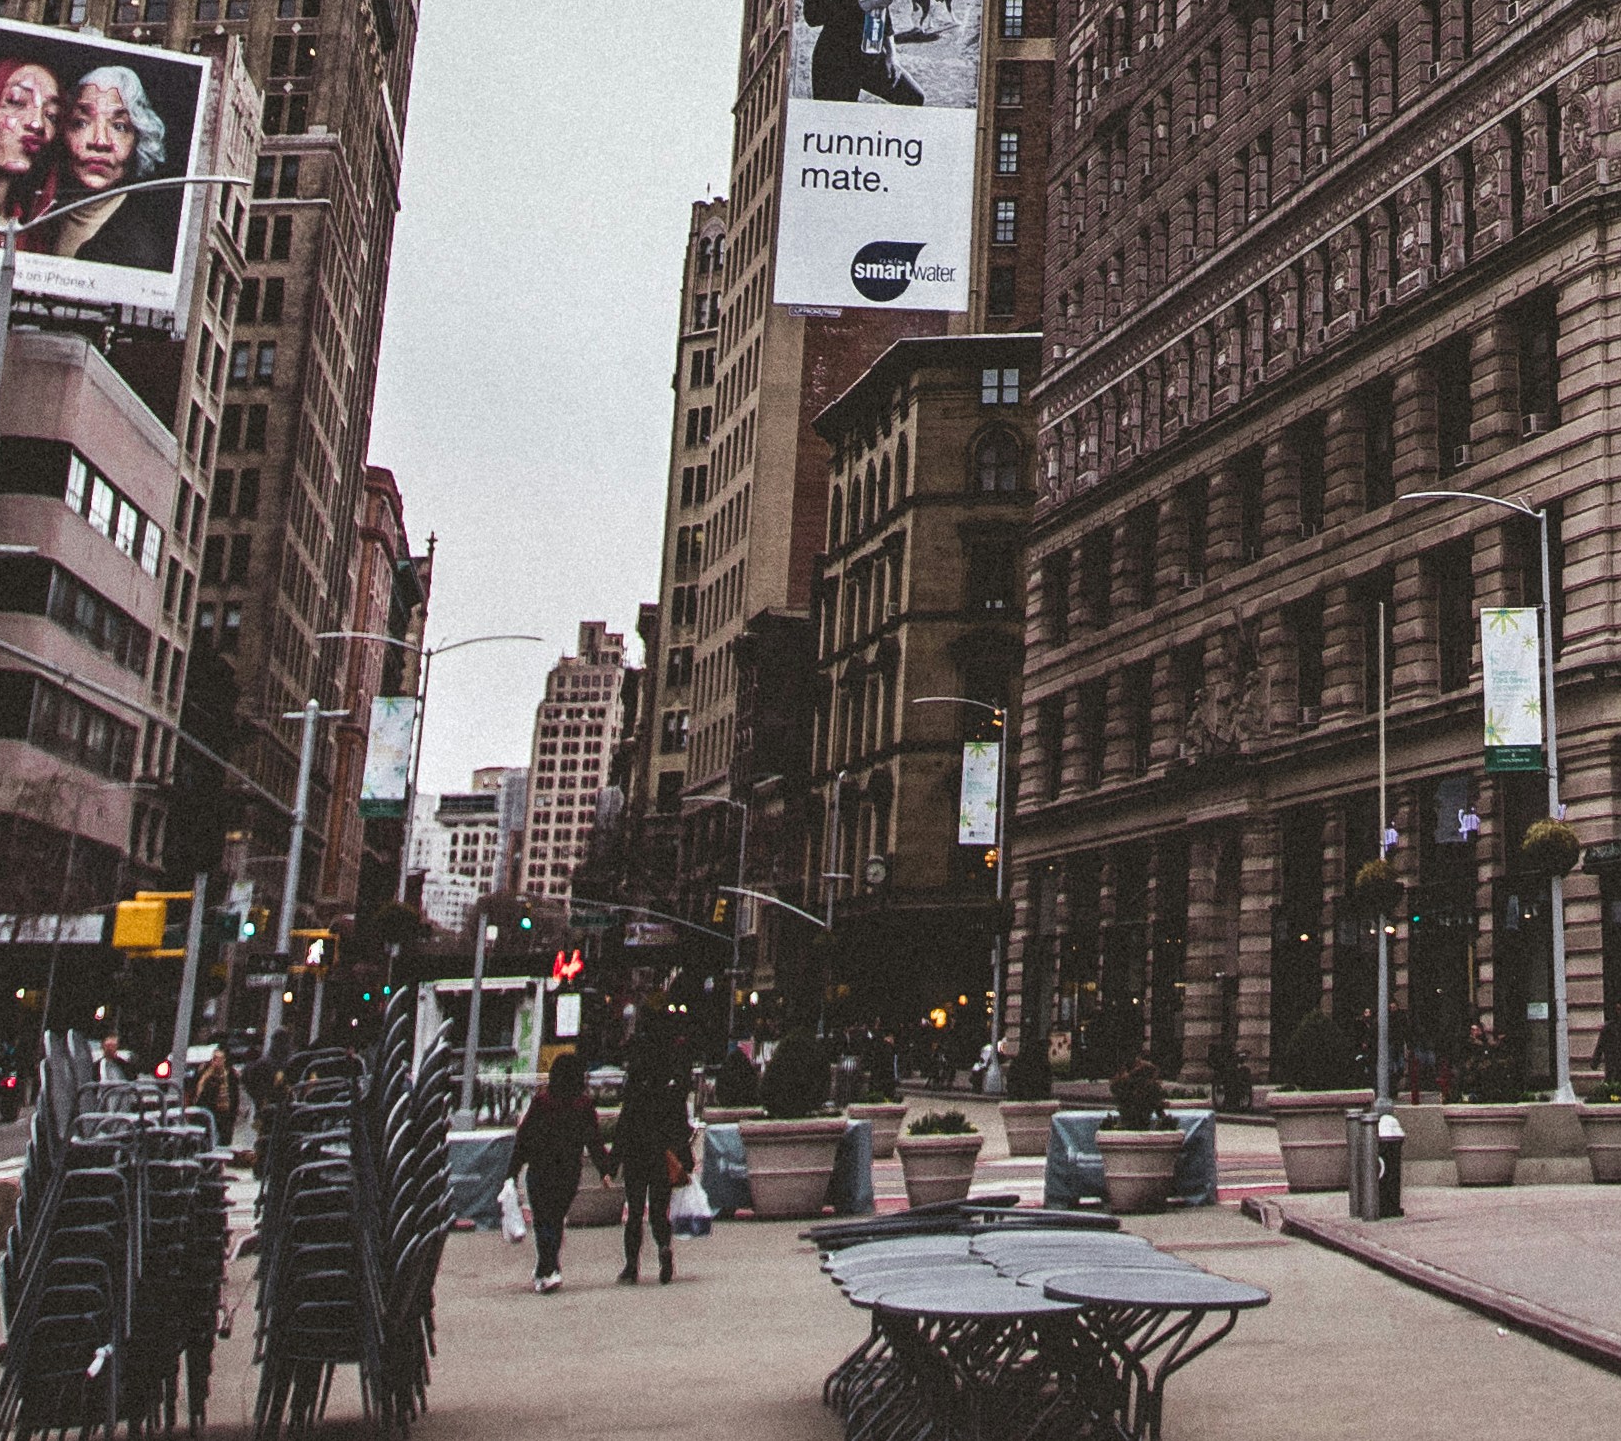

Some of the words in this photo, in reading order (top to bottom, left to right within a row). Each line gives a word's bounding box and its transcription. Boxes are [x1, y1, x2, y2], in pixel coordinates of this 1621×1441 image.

[803, 130, 923, 166] running
[801, 165, 889, 192] mate.
[44, 272, 86, 289] iPhone
[854, 261, 956, 282] smartwater
